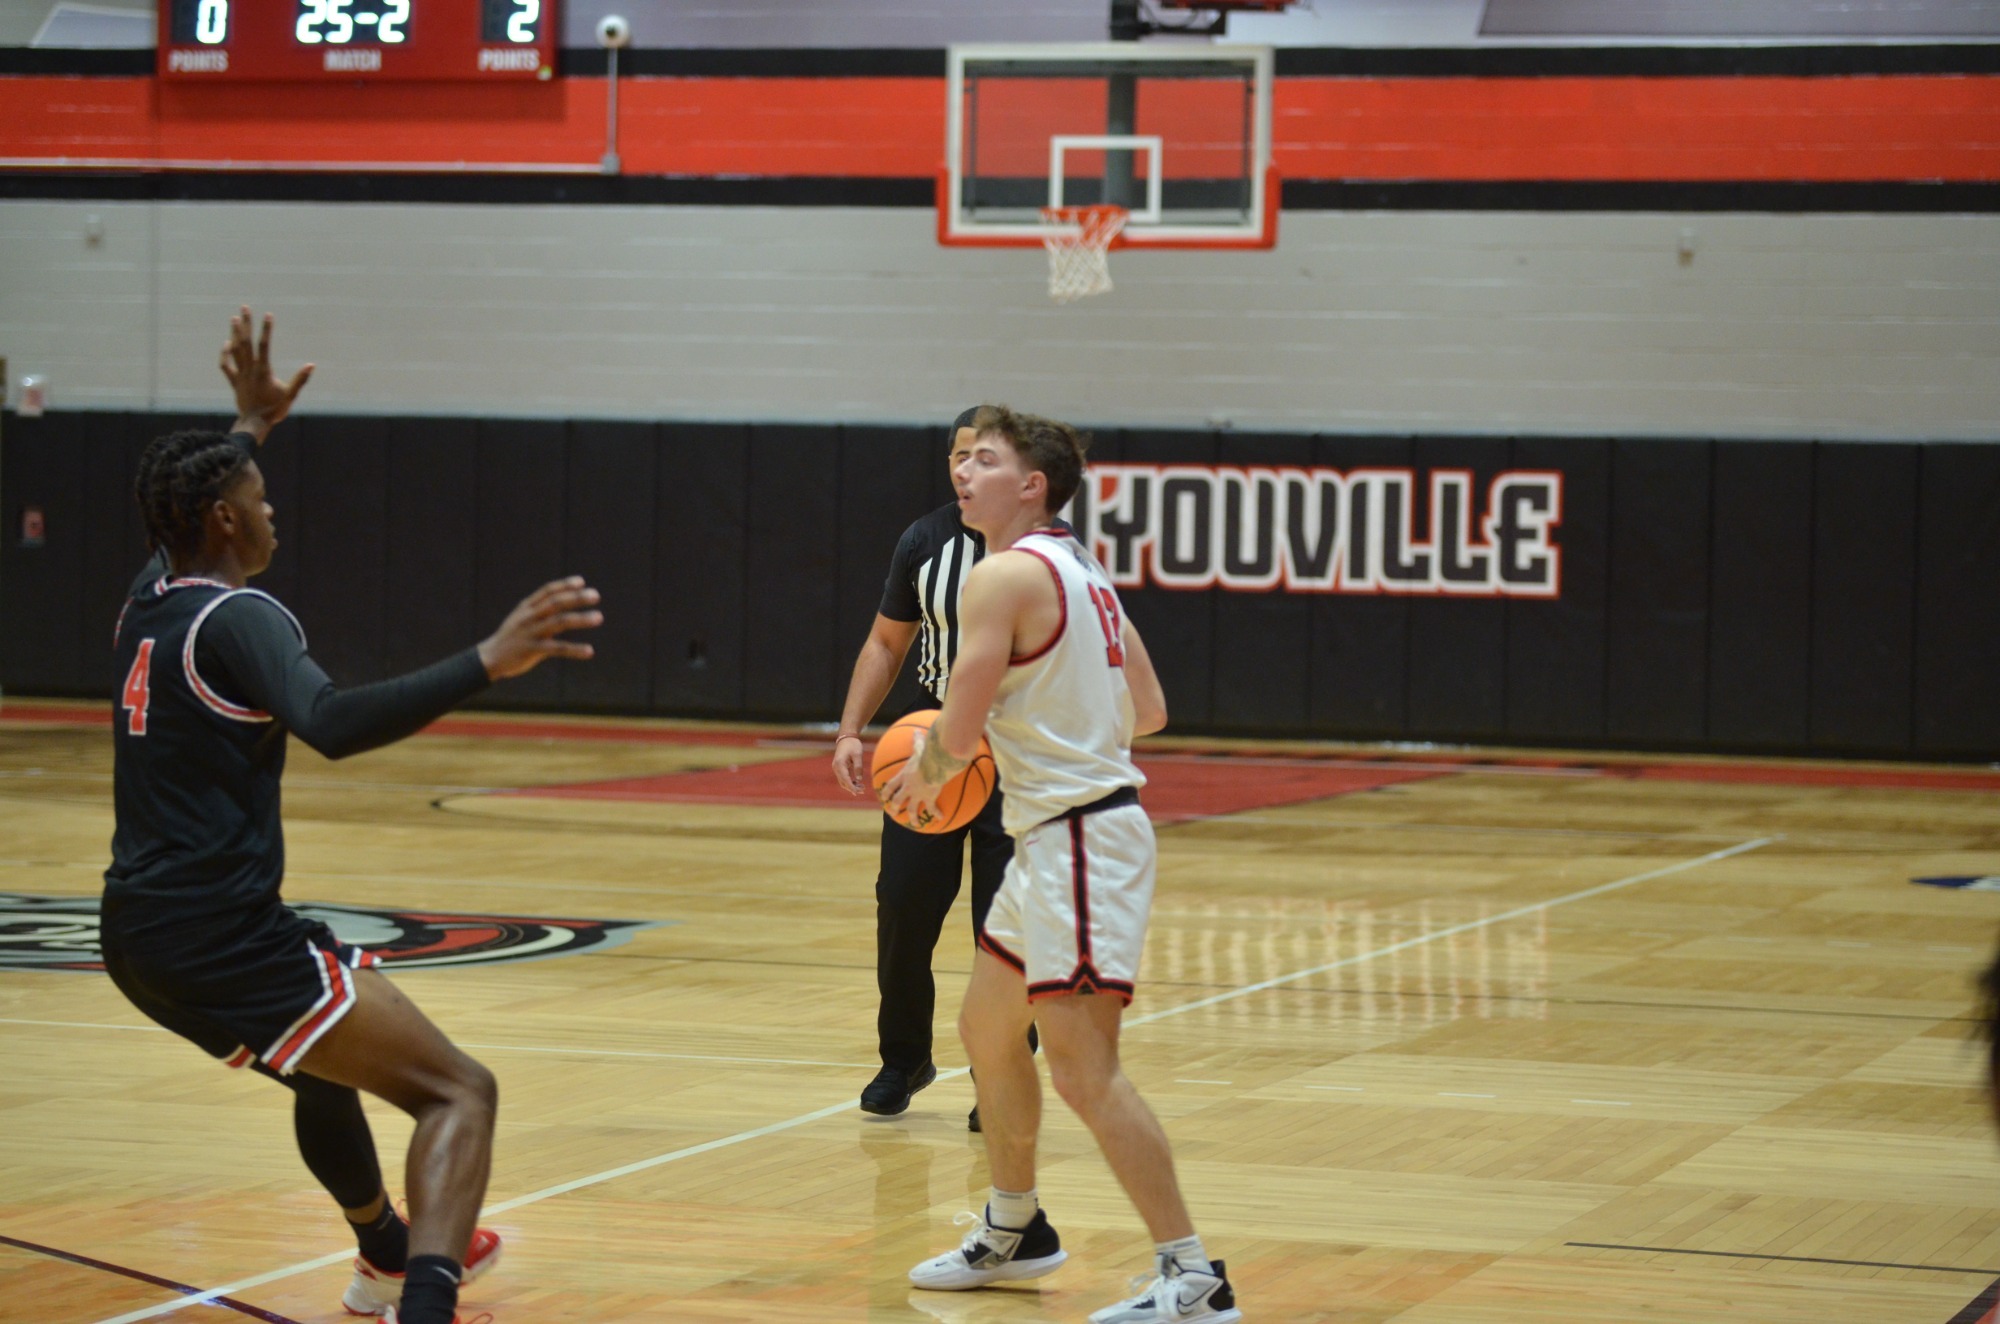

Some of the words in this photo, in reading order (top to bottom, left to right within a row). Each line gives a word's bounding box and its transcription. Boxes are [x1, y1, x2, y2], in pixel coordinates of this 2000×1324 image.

[196, 0, 228, 44] 0
[296, 0, 410, 44] 25-2
[507, 0, 540, 43] 2
[168, 49, 229, 72] POINTS
[323, 49, 382, 71] MATCH
[478, 48, 540, 71] POINTS
[122, 638, 156, 736] 4
